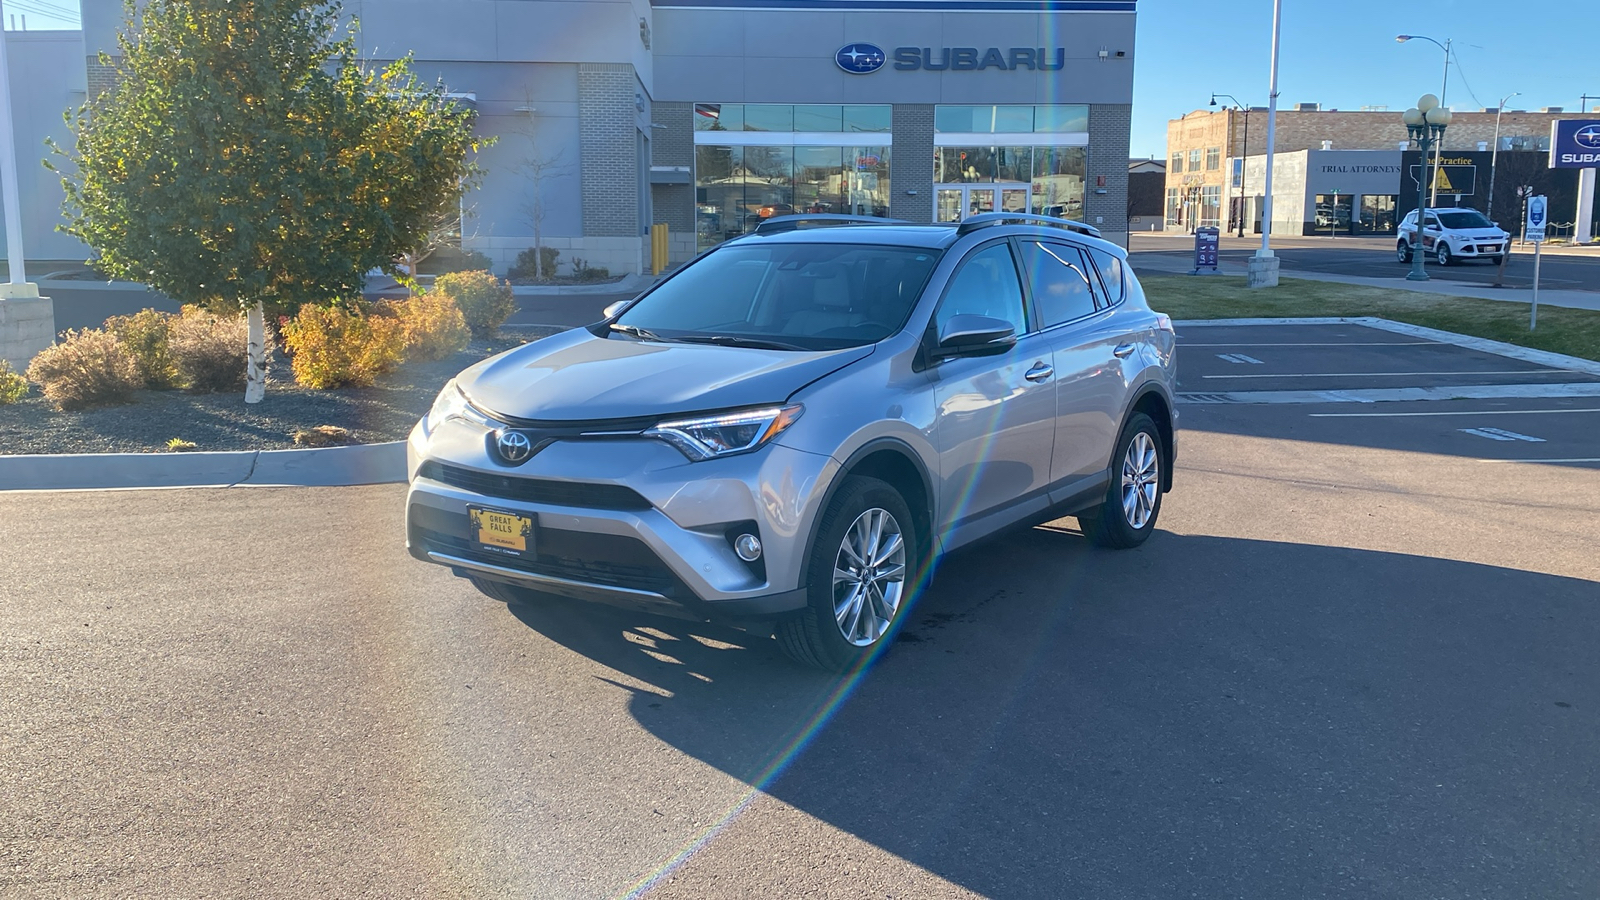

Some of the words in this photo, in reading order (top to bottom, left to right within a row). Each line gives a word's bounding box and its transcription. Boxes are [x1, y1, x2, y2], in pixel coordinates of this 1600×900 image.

[894, 47, 1065, 71] SUBARU
[1438, 156, 1473, 165] Practice
[1321, 165, 1349, 173] TRIAL
[1350, 165, 1400, 174] ATTORNEYS
[489, 515, 511, 525] GREAT
[490, 523, 512, 533] FALLS
